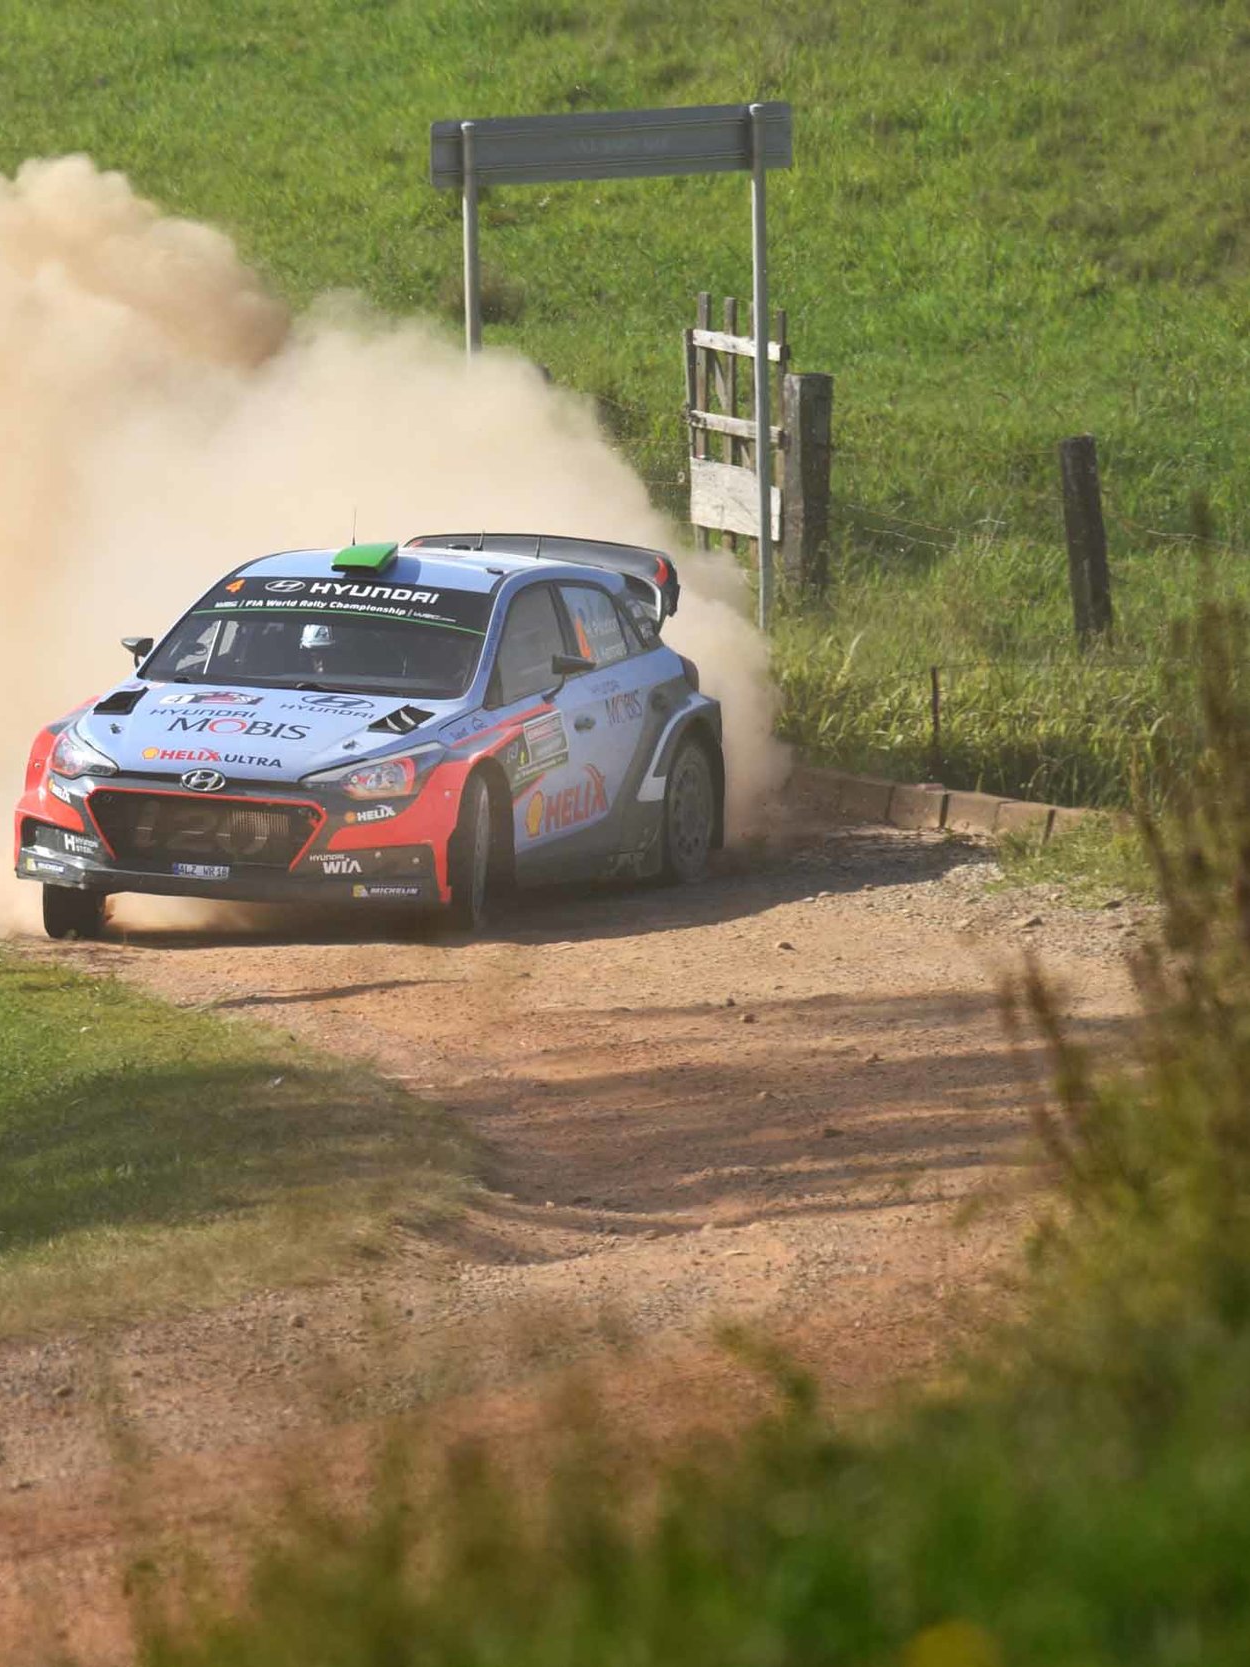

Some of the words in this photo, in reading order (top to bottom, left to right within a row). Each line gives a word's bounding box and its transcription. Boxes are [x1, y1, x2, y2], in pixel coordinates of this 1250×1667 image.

[225, 578, 246, 593] 4
[309, 582, 440, 604] HYUNDAI
[245, 600, 263, 608] FIA
[266, 599, 297, 608] World
[300, 600, 327, 611] Rally
[329, 601, 406, 616] Championship
[150, 708, 257, 718] HYUNDAI
[279, 703, 374, 719] HYUNDAI
[167, 717, 311, 740] MOBIS
[159, 747, 223, 763] HELIX
[224, 753, 283, 768] ULTRA
[544, 763, 609, 833] HELIX
[356, 804, 397, 822] HELIX
[323, 858, 362, 874] WIA
